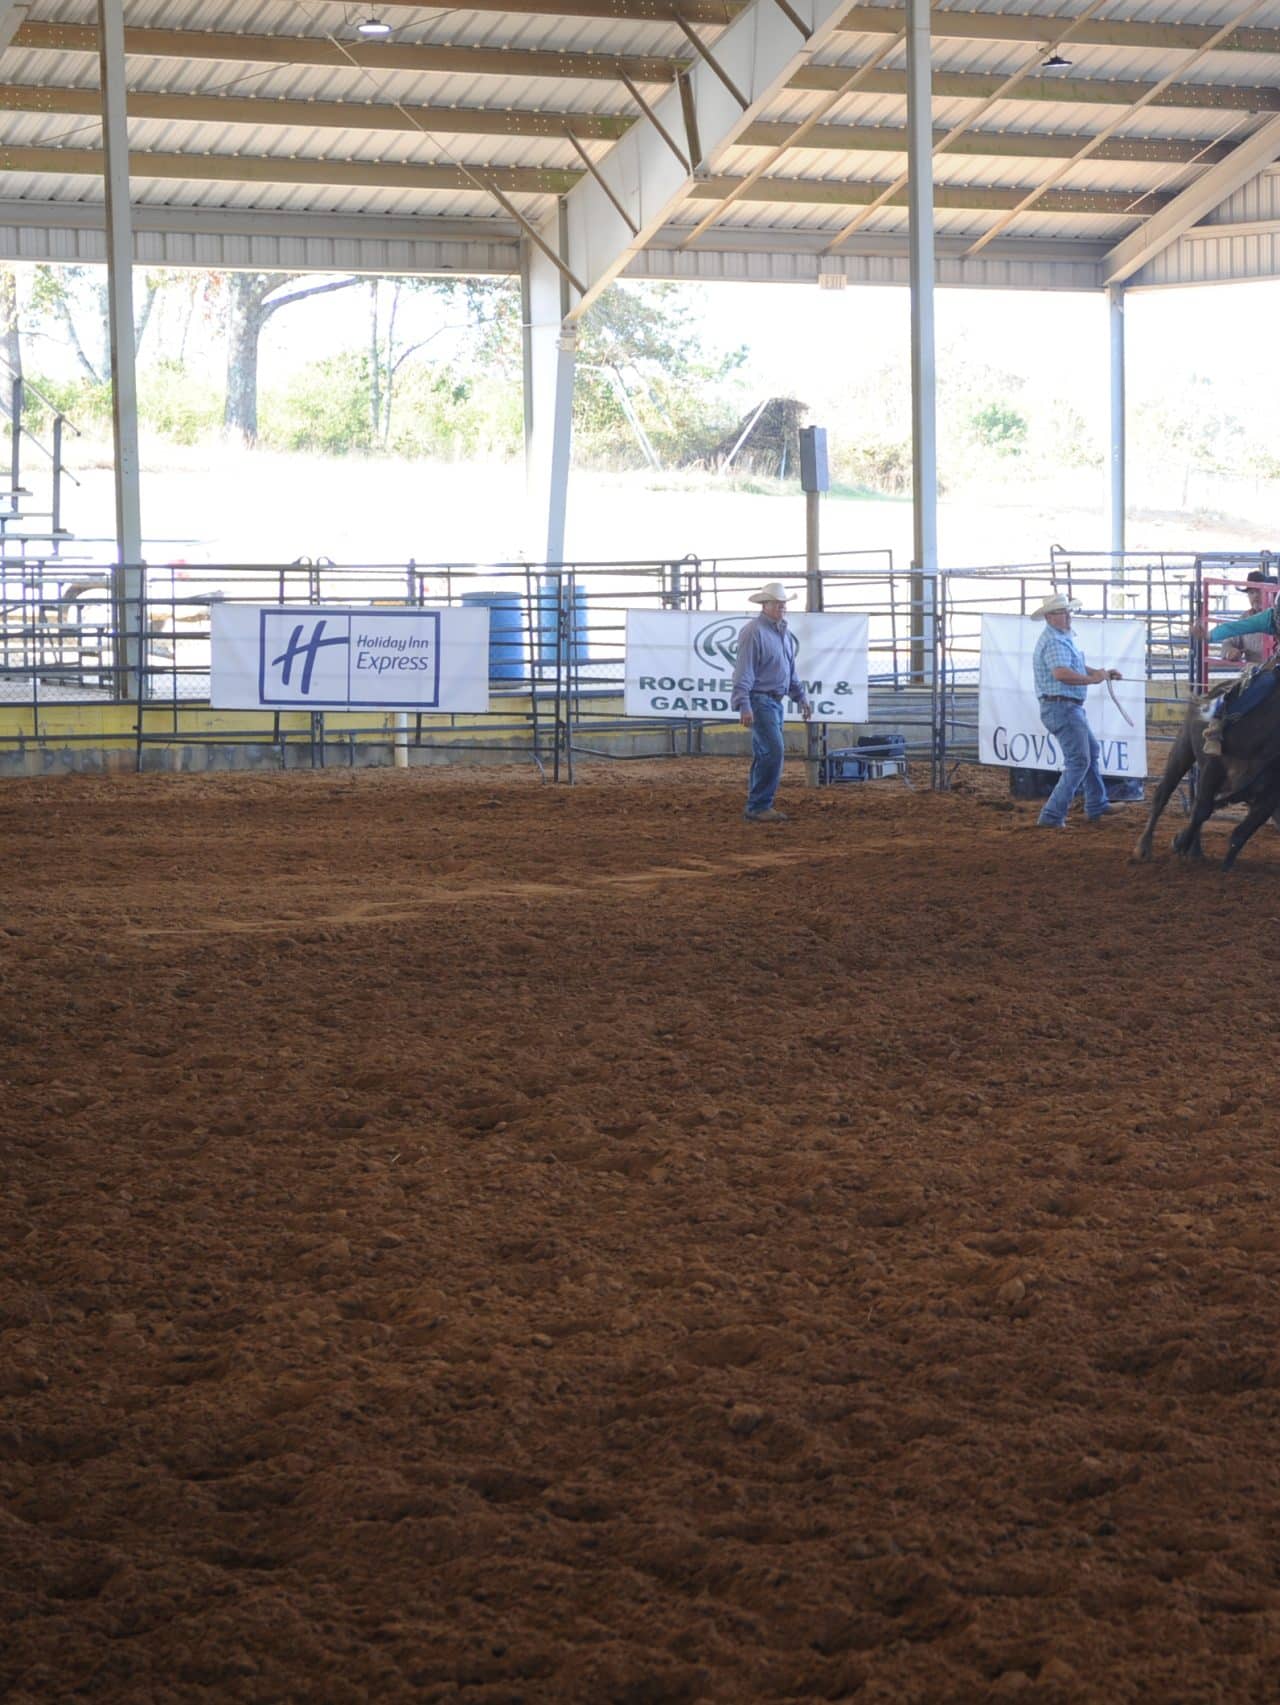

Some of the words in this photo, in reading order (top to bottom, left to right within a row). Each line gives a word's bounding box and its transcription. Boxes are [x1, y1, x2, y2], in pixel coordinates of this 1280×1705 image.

[356, 634, 407, 651] Holiday
[408, 635, 429, 648] Inn
[356, 651, 429, 674] Express
